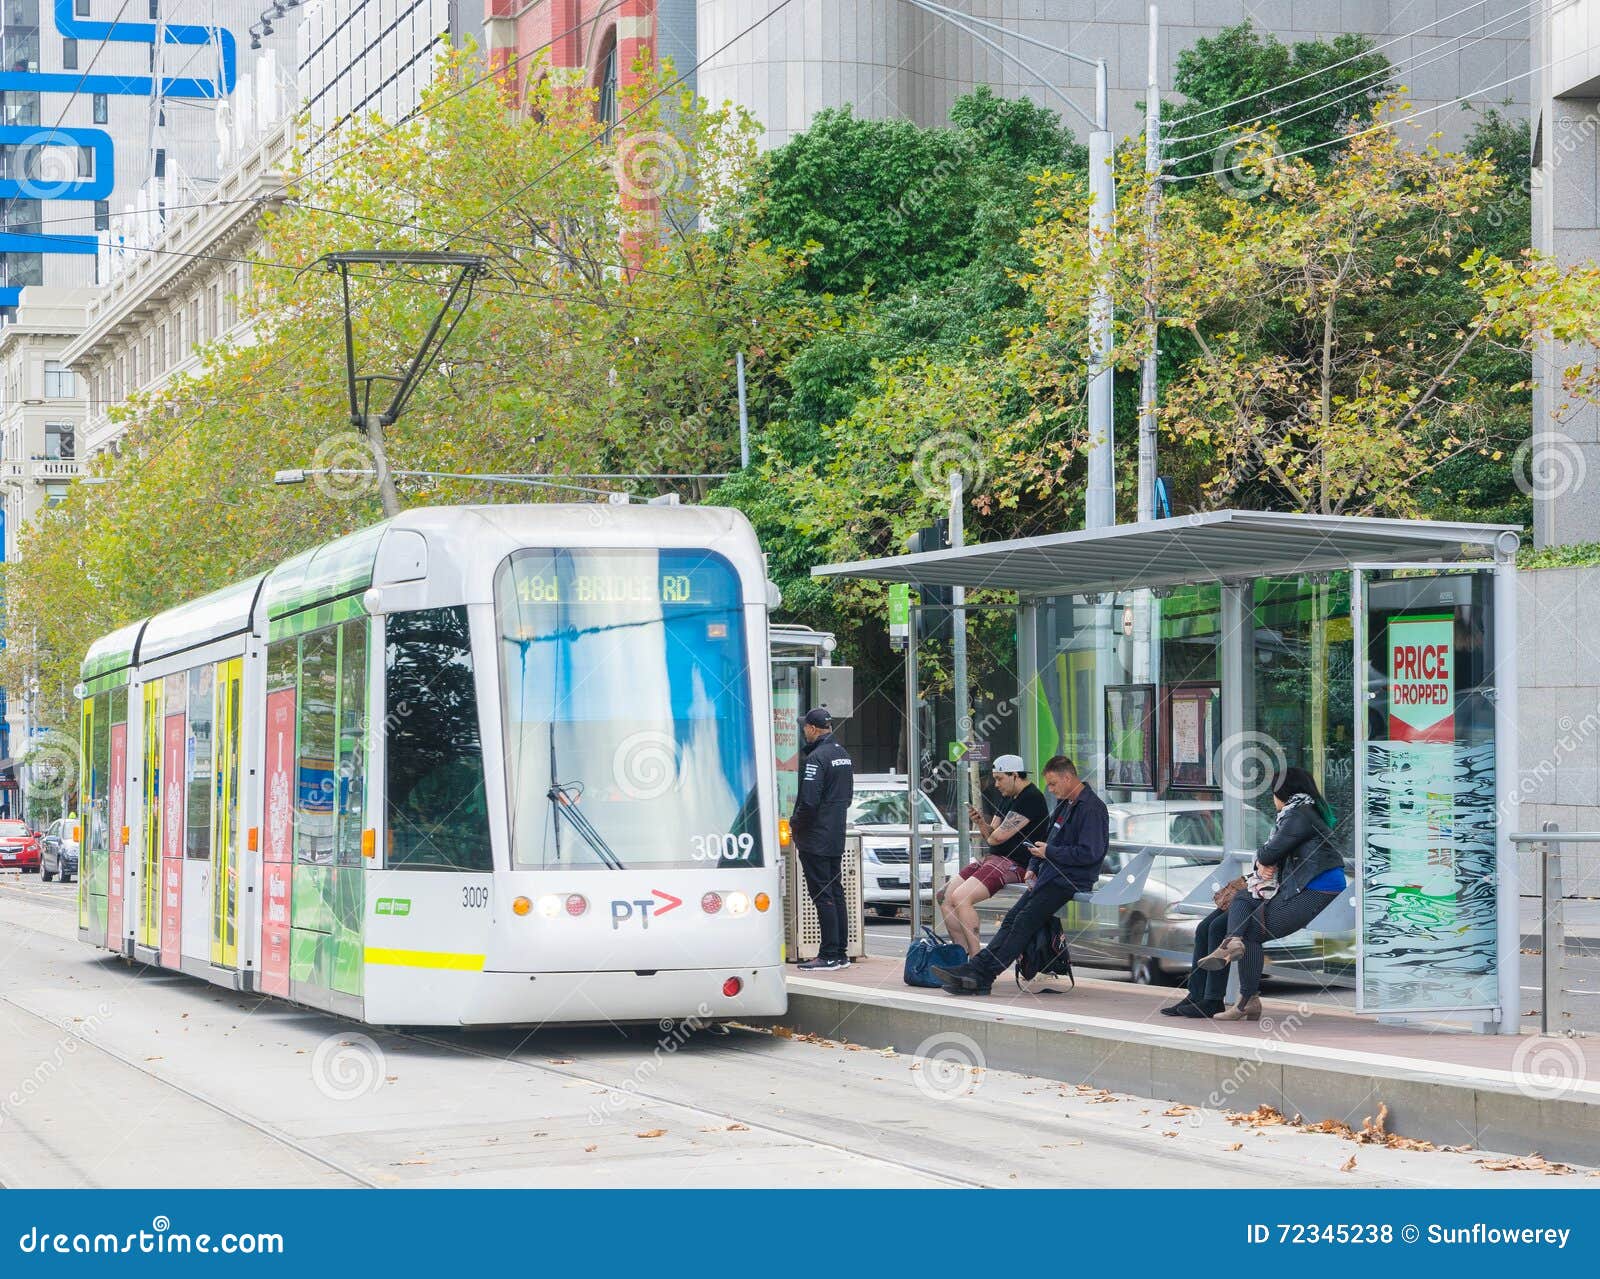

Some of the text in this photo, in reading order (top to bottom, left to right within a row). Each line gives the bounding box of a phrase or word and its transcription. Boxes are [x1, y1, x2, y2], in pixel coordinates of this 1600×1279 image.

[577, 576, 653, 601] BRIDGE
[663, 576, 690, 601] RD
[1393, 644, 1449, 680] PRICE
[1393, 683, 1449, 705] DROPPED
[689, 833, 754, 861] 3009
[462, 886, 489, 909] 3009
